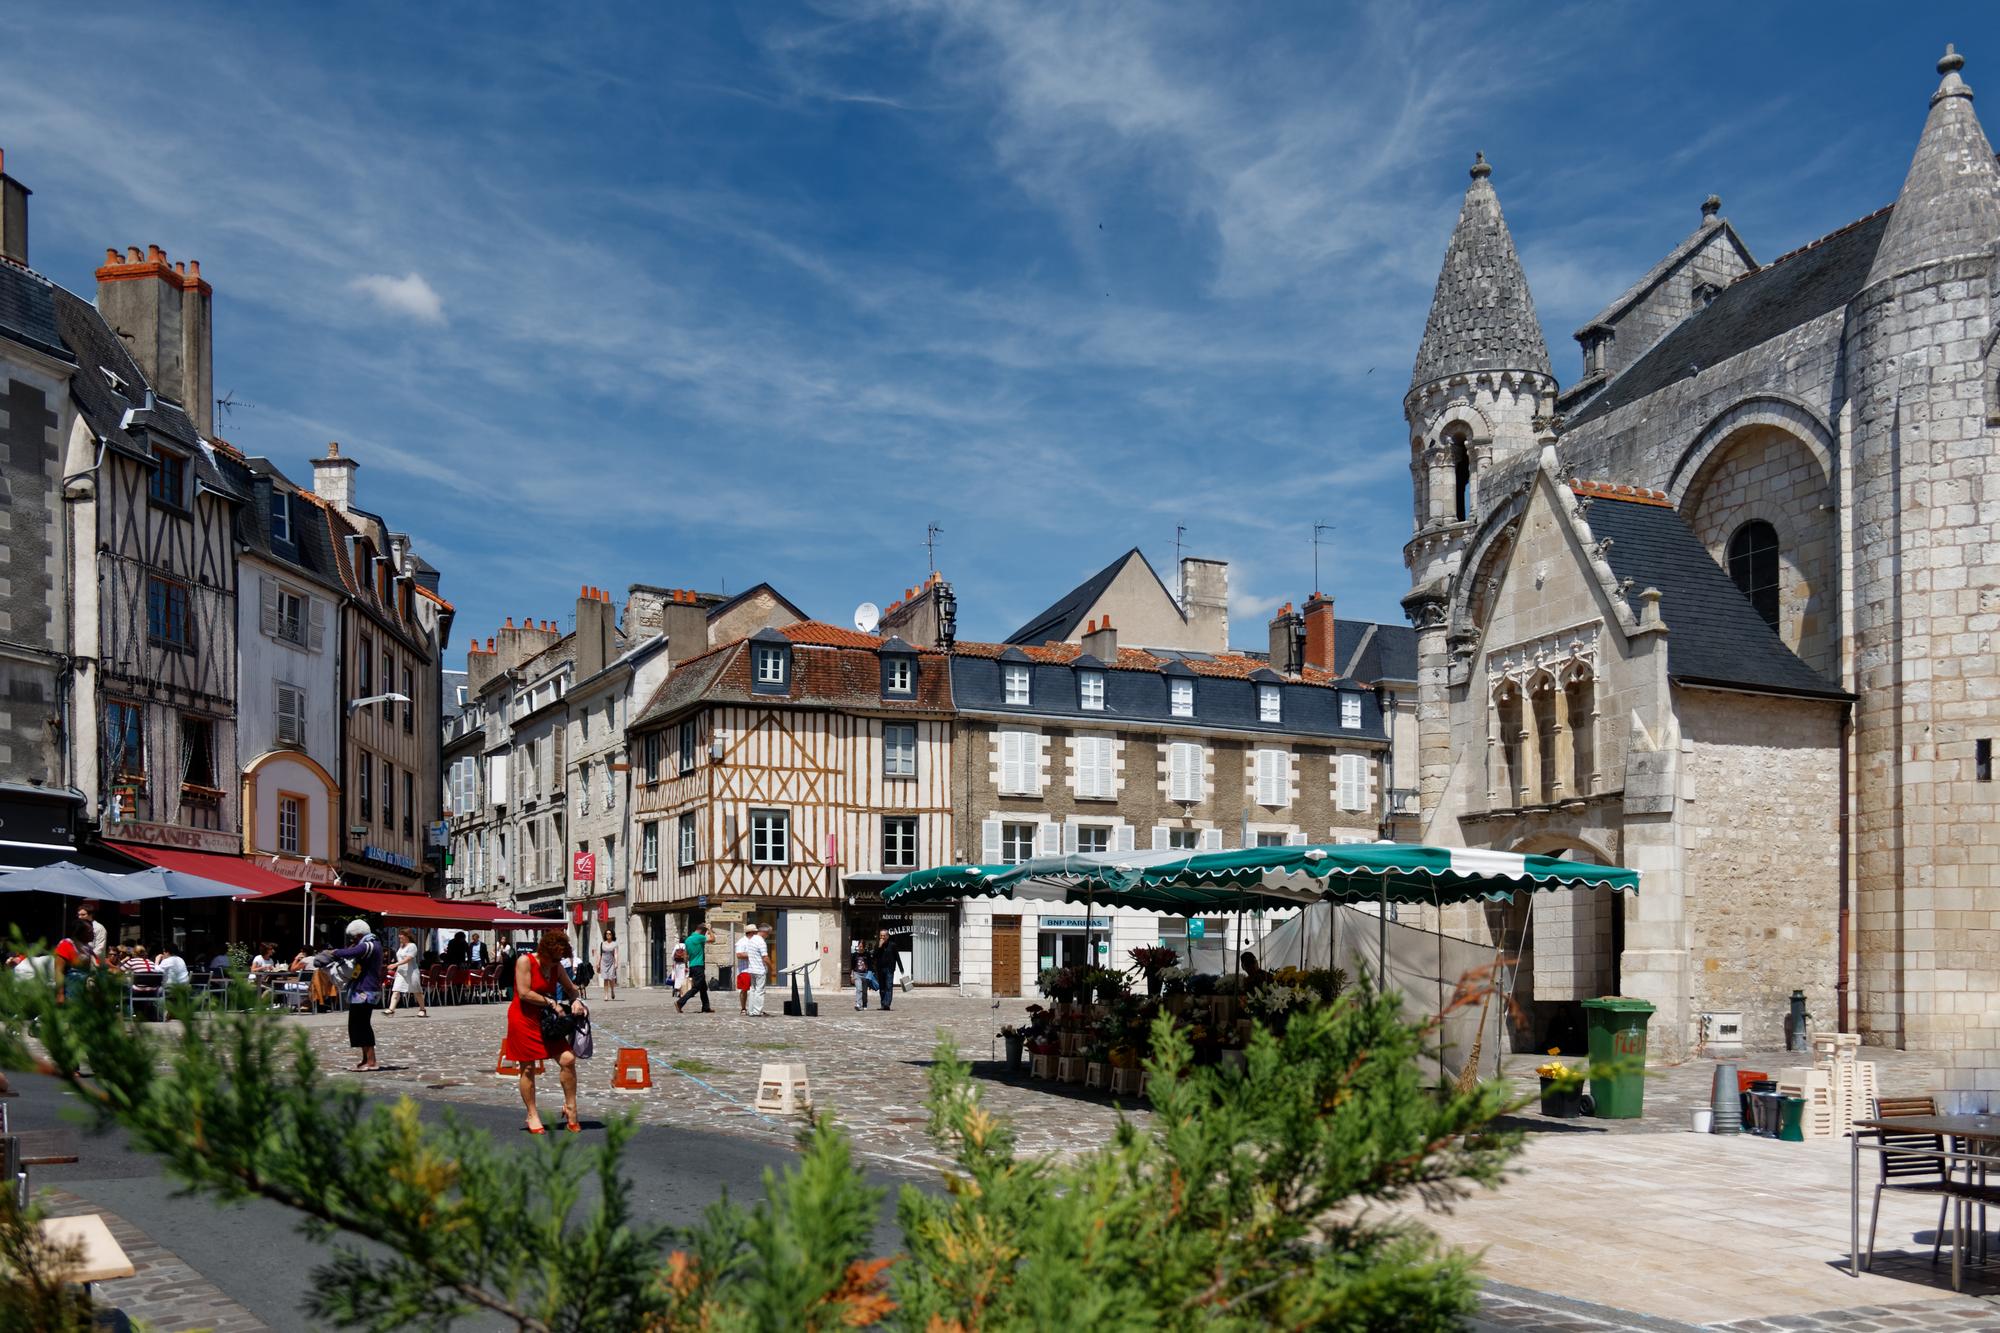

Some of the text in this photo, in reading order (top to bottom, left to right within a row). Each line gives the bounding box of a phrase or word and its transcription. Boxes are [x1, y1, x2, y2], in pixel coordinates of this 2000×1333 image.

[106, 821, 202, 848] L'ARGANIER
[1047, 919, 1065, 927] BNP
[888, 925, 939, 936] GALERIE D'ART
